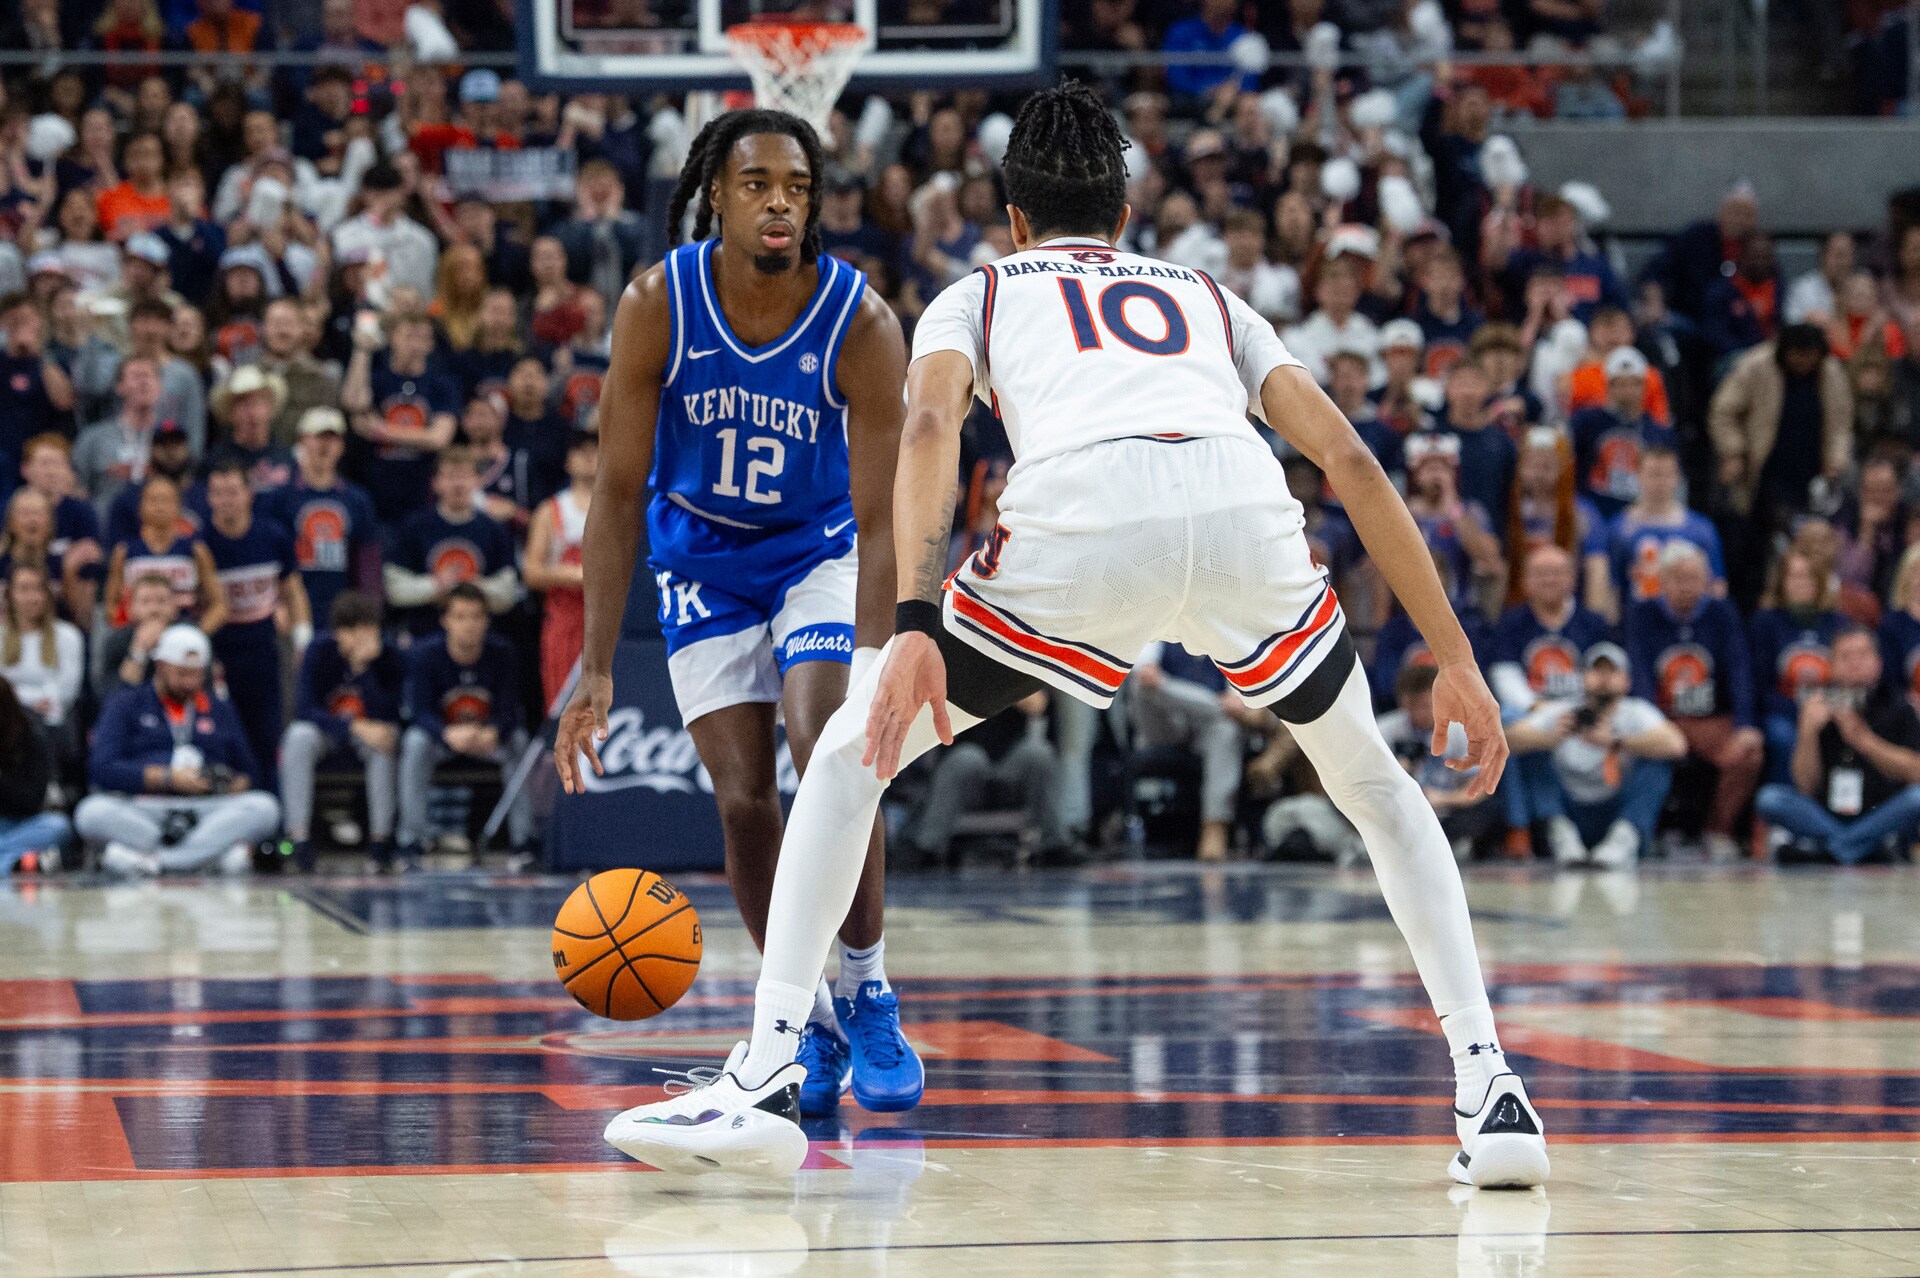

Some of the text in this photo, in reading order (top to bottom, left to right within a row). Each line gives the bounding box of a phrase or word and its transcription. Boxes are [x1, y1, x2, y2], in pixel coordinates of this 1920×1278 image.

[1001, 261, 1199, 285] BAKER-MAZARA
[1056, 276, 1190, 356] 10
[683, 385, 820, 444] KENTUCKY
[712, 428, 786, 505] 12
[785, 630, 853, 660] Wildcats
